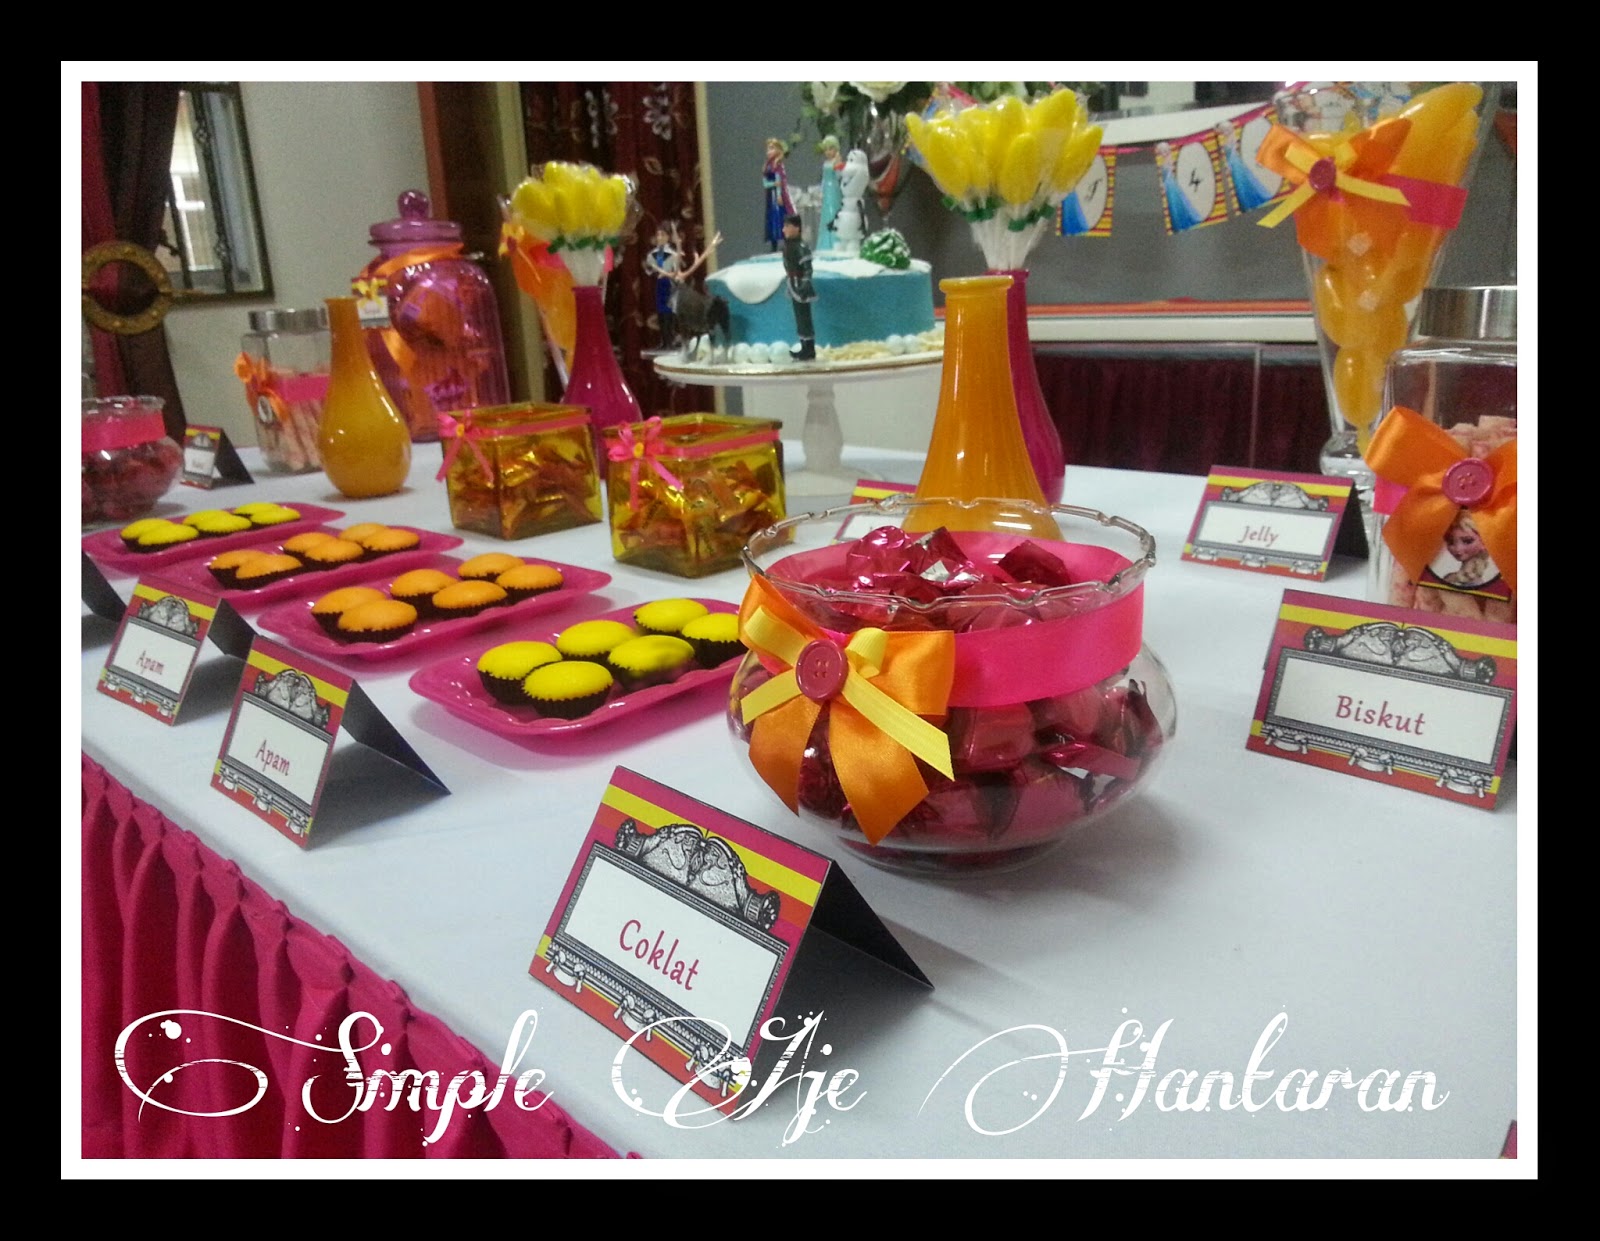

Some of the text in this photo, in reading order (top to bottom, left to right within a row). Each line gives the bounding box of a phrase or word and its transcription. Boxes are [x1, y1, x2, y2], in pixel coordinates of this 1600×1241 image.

[1237, 525, 1279, 547] Jelly
[138, 651, 165, 676] Apam
[1336, 695, 1426, 736] Biskut
[256, 739, 291, 777] Apam
[619, 919, 699, 991] Coklat
